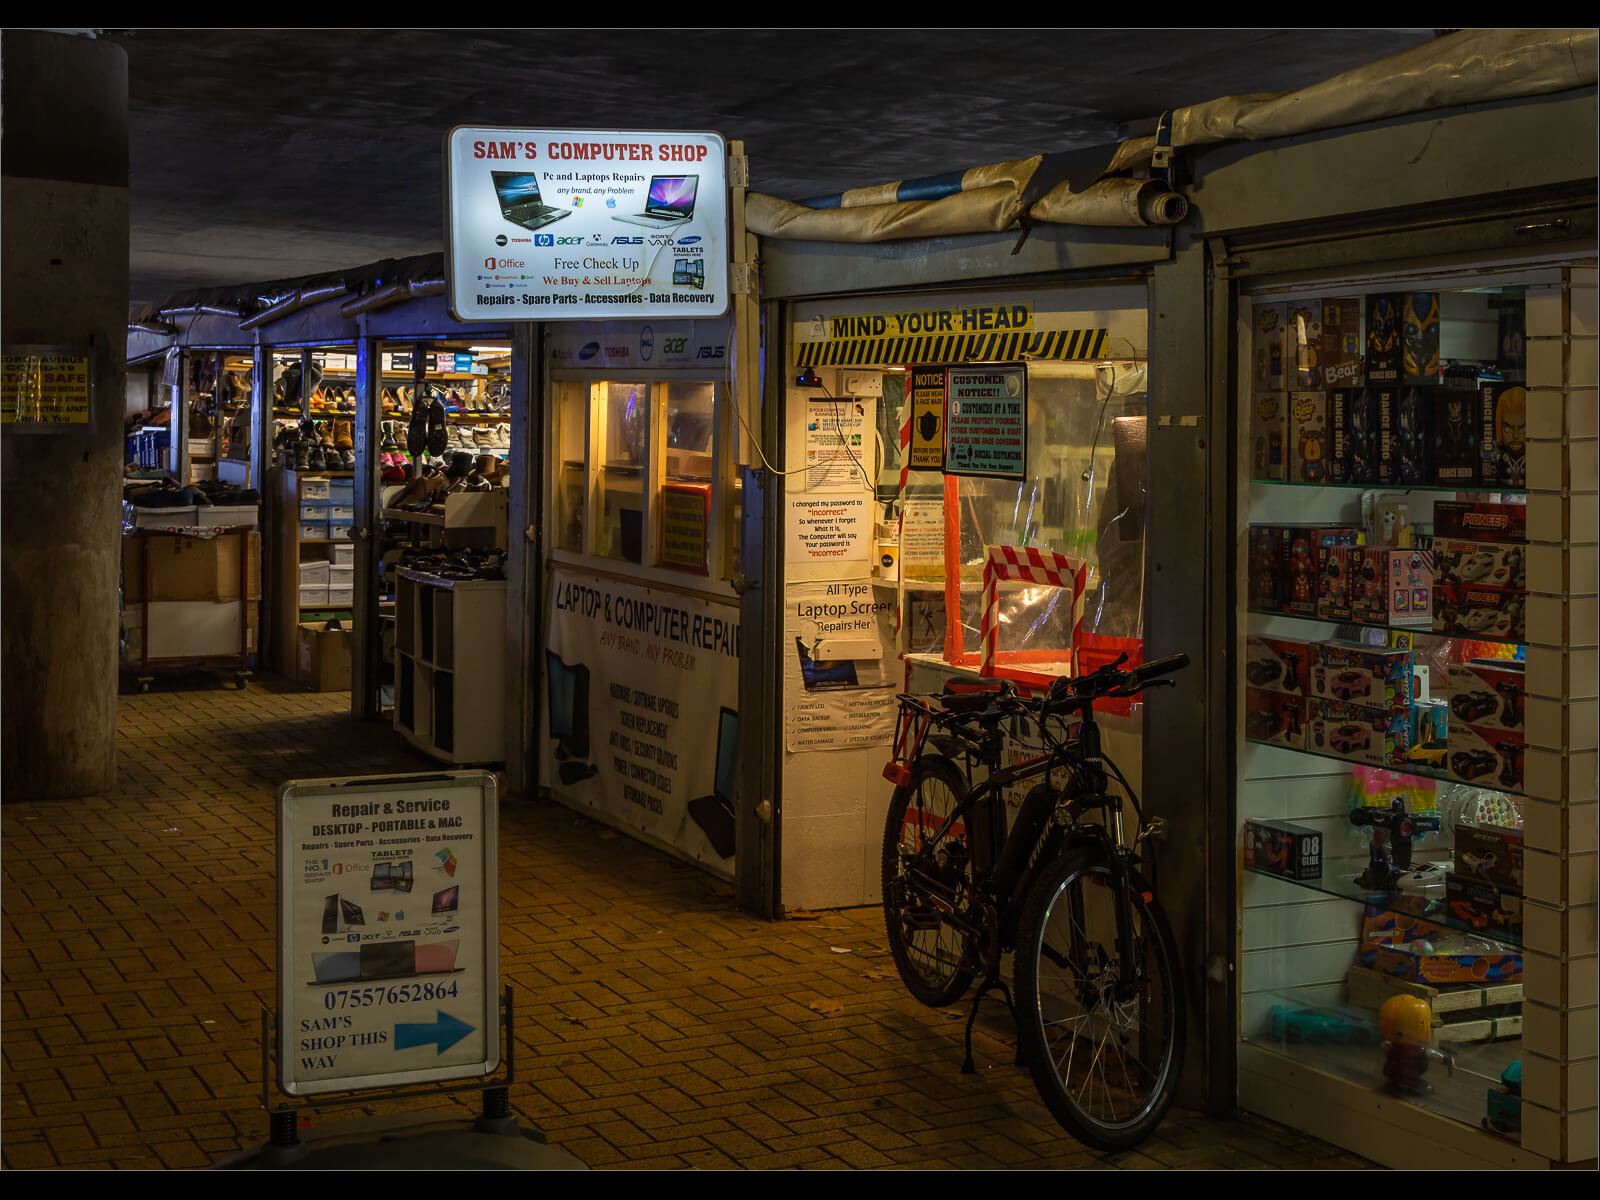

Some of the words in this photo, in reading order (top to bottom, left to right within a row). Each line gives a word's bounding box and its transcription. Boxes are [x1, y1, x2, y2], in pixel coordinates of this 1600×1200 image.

[474, 141, 537, 160] SAM'S
[548, 142, 654, 161] COMPUTER
[658, 144, 708, 162] SHOP
[543, 172, 554, 181] Pc
[556, 172, 572, 181] and
[575, 172, 610, 183] Laptops
[612, 172, 645, 183] Repairs
[571, 186, 592, 195] brand,
[556, 236, 584, 245] acer
[611, 236, 644, 244] ASUS
[499, 258, 525, 268] Office
[554, 258, 579, 269] Free
[583, 258, 619, 269] Check
[623, 258, 639, 272] Up
[543, 276, 557, 285] We
[561, 276, 580, 287] Buy
[582, 276, 592, 285] &
[594, 276, 610, 285] Sell
[614, 276, 652, 287] Laptops
[477, 294, 515, 306] Repairs
[522, 294, 550, 306] Spare
[553, 294, 577, 304] Parts
[584, 293, 642, 304] Accessories
[650, 293, 670, 303] Data
[672, 293, 714, 304] Recovery
[833, 316, 886, 338] MIND
[894, 310, 952, 334] YOUR
[962, 306, 1029, 331] HEAD
[605, 346, 629, 358] TOSHIBA
[664, 338, 688, 353] acer
[697, 346, 726, 358] ASUS
[44, 374, 86, 383] SAFE
[915, 374, 944, 386] NOTICE
[953, 376, 1005, 384] CUSTOMER
[1326, 364, 1358, 384] Bear
[958, 388, 1000, 397] NOTICE!!
[962, 403, 992, 414] CUSTOMERS
[995, 403, 1001, 414] AT
[975, 450, 991, 459] SOCIAL
[1463, 513, 1508, 528] PIONEER
[826, 584, 840, 595] All
[843, 584, 868, 597] Type
[557, 581, 600, 619] LAPTOP
[605, 594, 611, 622] &
[615, 596, 688, 643] COMPUTER
[798, 603, 846, 619] Laptop
[818, 621, 851, 633] Repairs
[600, 632, 615, 648] ANY
[663, 648, 696, 672] PROBLEM
[1328, 655, 1349, 667] Racing
[332, 803, 380, 819] Repair
[384, 801, 393, 814] &
[396, 798, 450, 813] Service
[312, 822, 363, 836] DESKTOP
[372, 819, 426, 833] PORTABLE
[428, 820, 436, 829] &
[438, 816, 462, 828] MAC
[302, 842, 329, 851] Repairs
[334, 840, 354, 849] Spare
[378, 837, 421, 845] Accessories
[442, 834, 473, 842] Recovery
[1302, 836, 1320, 856] 08
[371, 849, 413, 857] TABLETS
[321, 859, 328, 870] 1
[1302, 856, 1320, 866] GLIDE
[346, 864, 369, 872] Office
[324, 980, 458, 1010] 07557652864
[301, 1016, 352, 1032] SAM'S
[301, 1036, 345, 1051] SHOP
[349, 1031, 387, 1046] THIS
[301, 1056, 337, 1070] WAY
